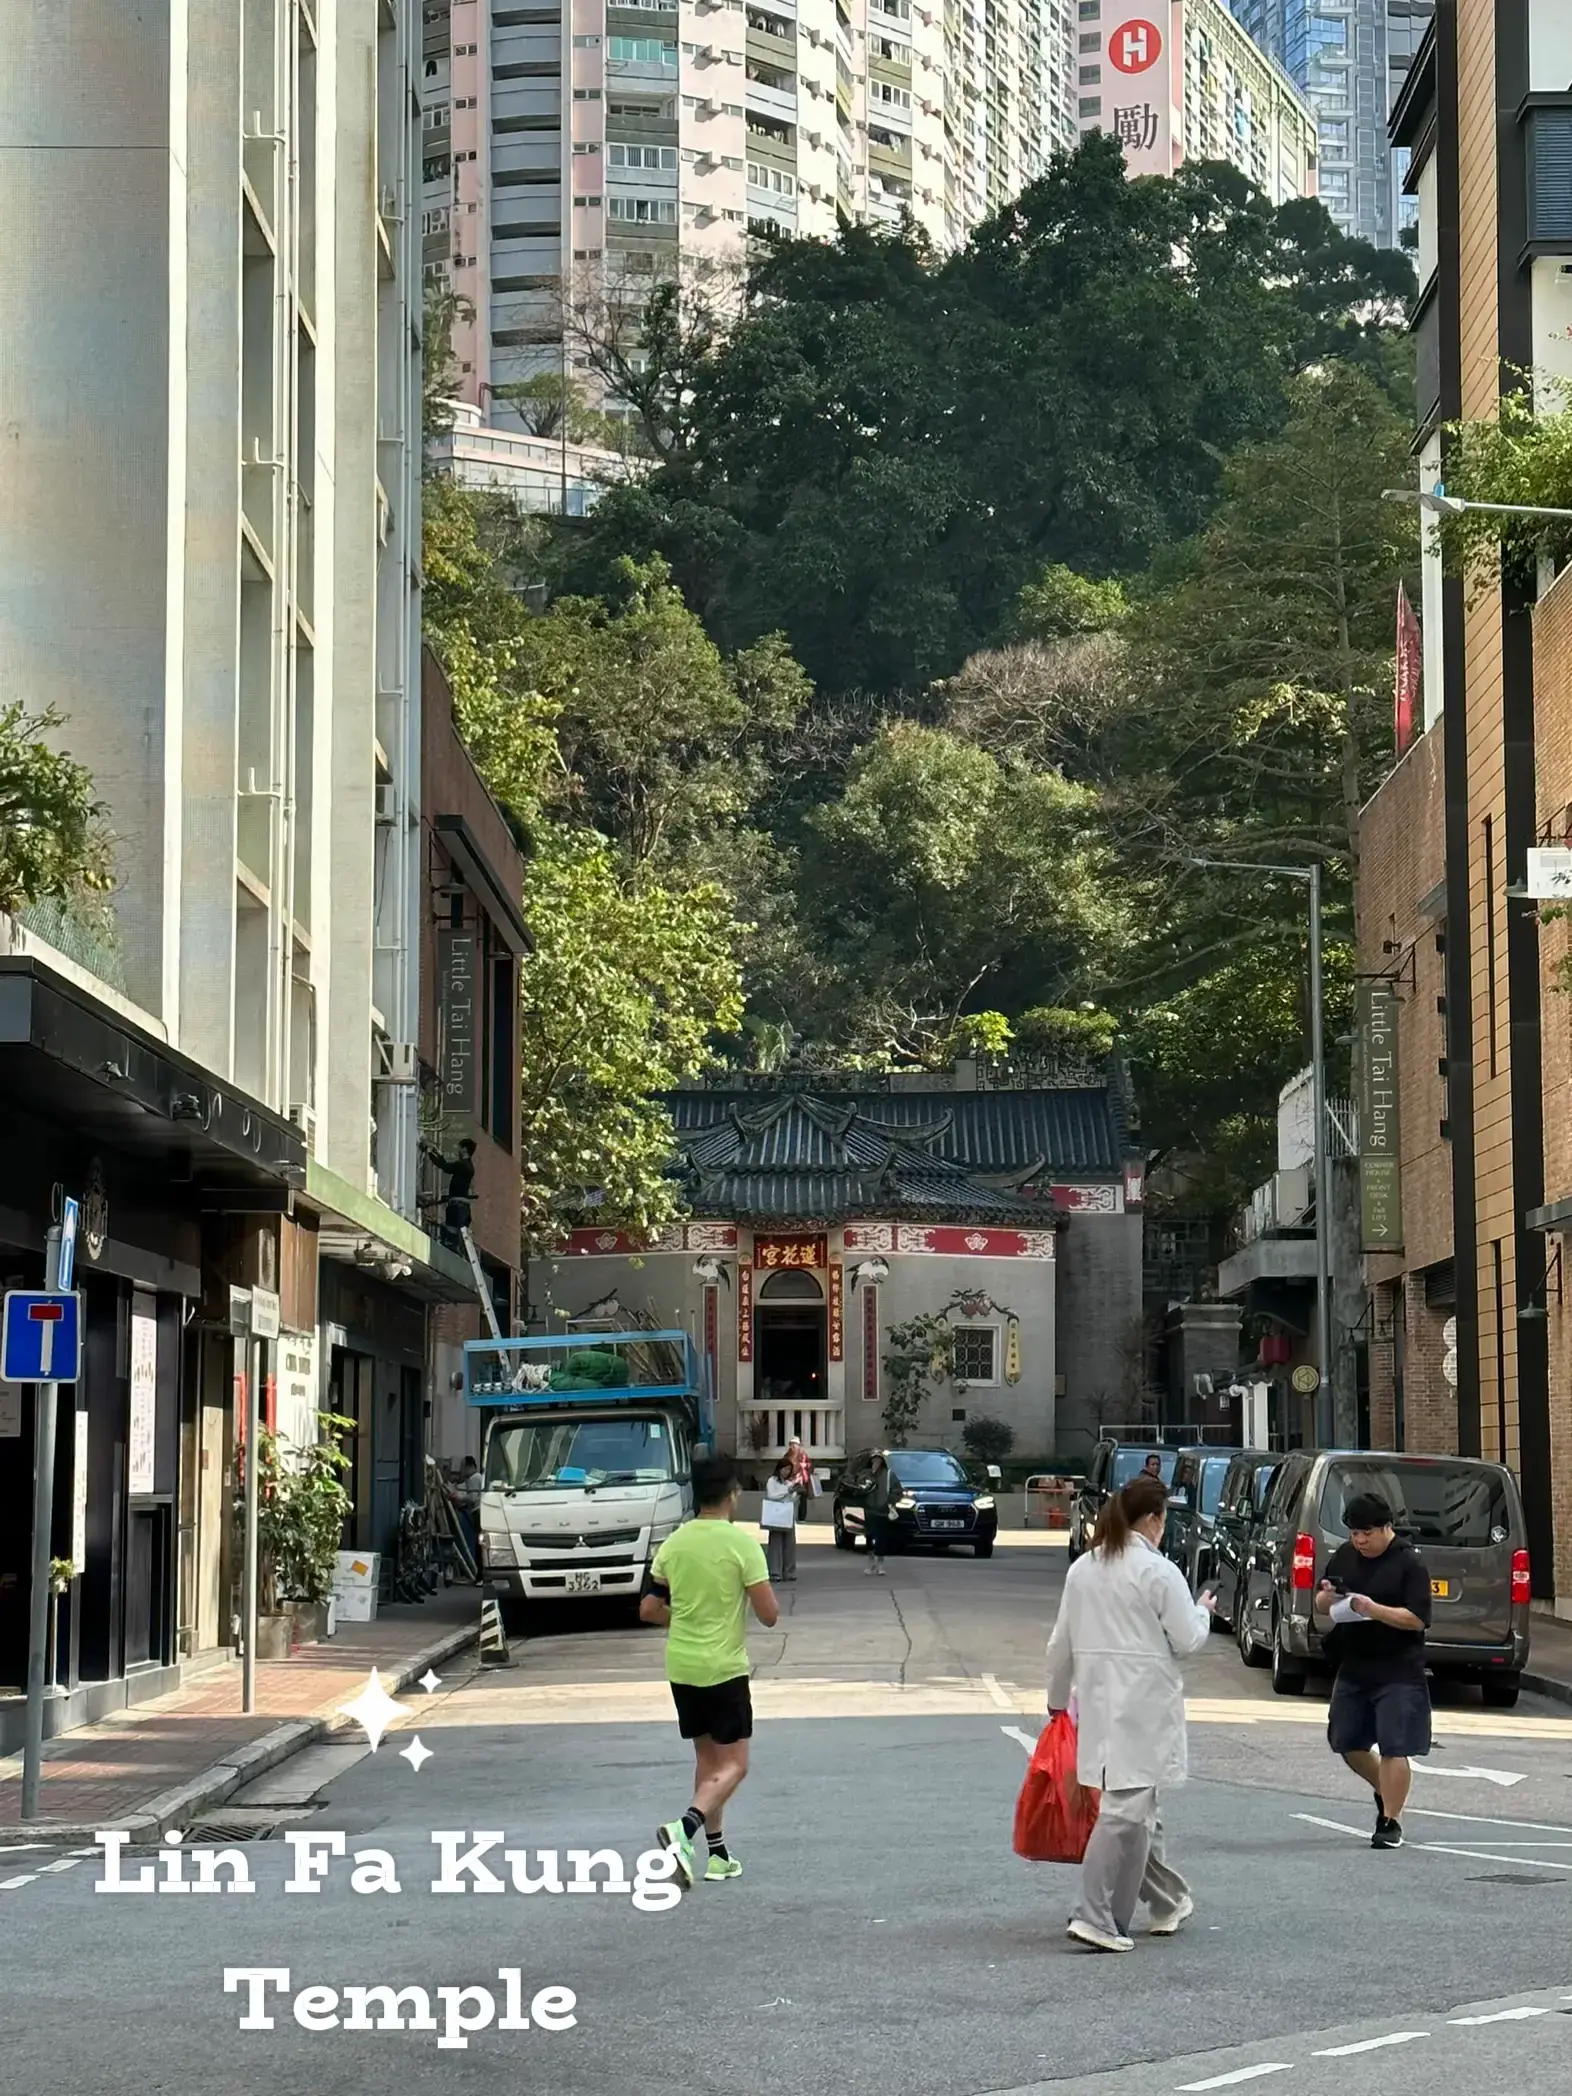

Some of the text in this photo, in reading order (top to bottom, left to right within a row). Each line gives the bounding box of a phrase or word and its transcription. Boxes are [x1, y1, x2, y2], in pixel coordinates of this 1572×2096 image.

[1113, 102, 1159, 151] 勵
[451, 938, 472, 992] Little
[451, 998, 471, 1029] Tai
[446, 1038, 471, 1095] Hang
[1370, 992, 1393, 1148] Little Tai Hang
[762, 1243, 819, 1265] 蓮花宮
